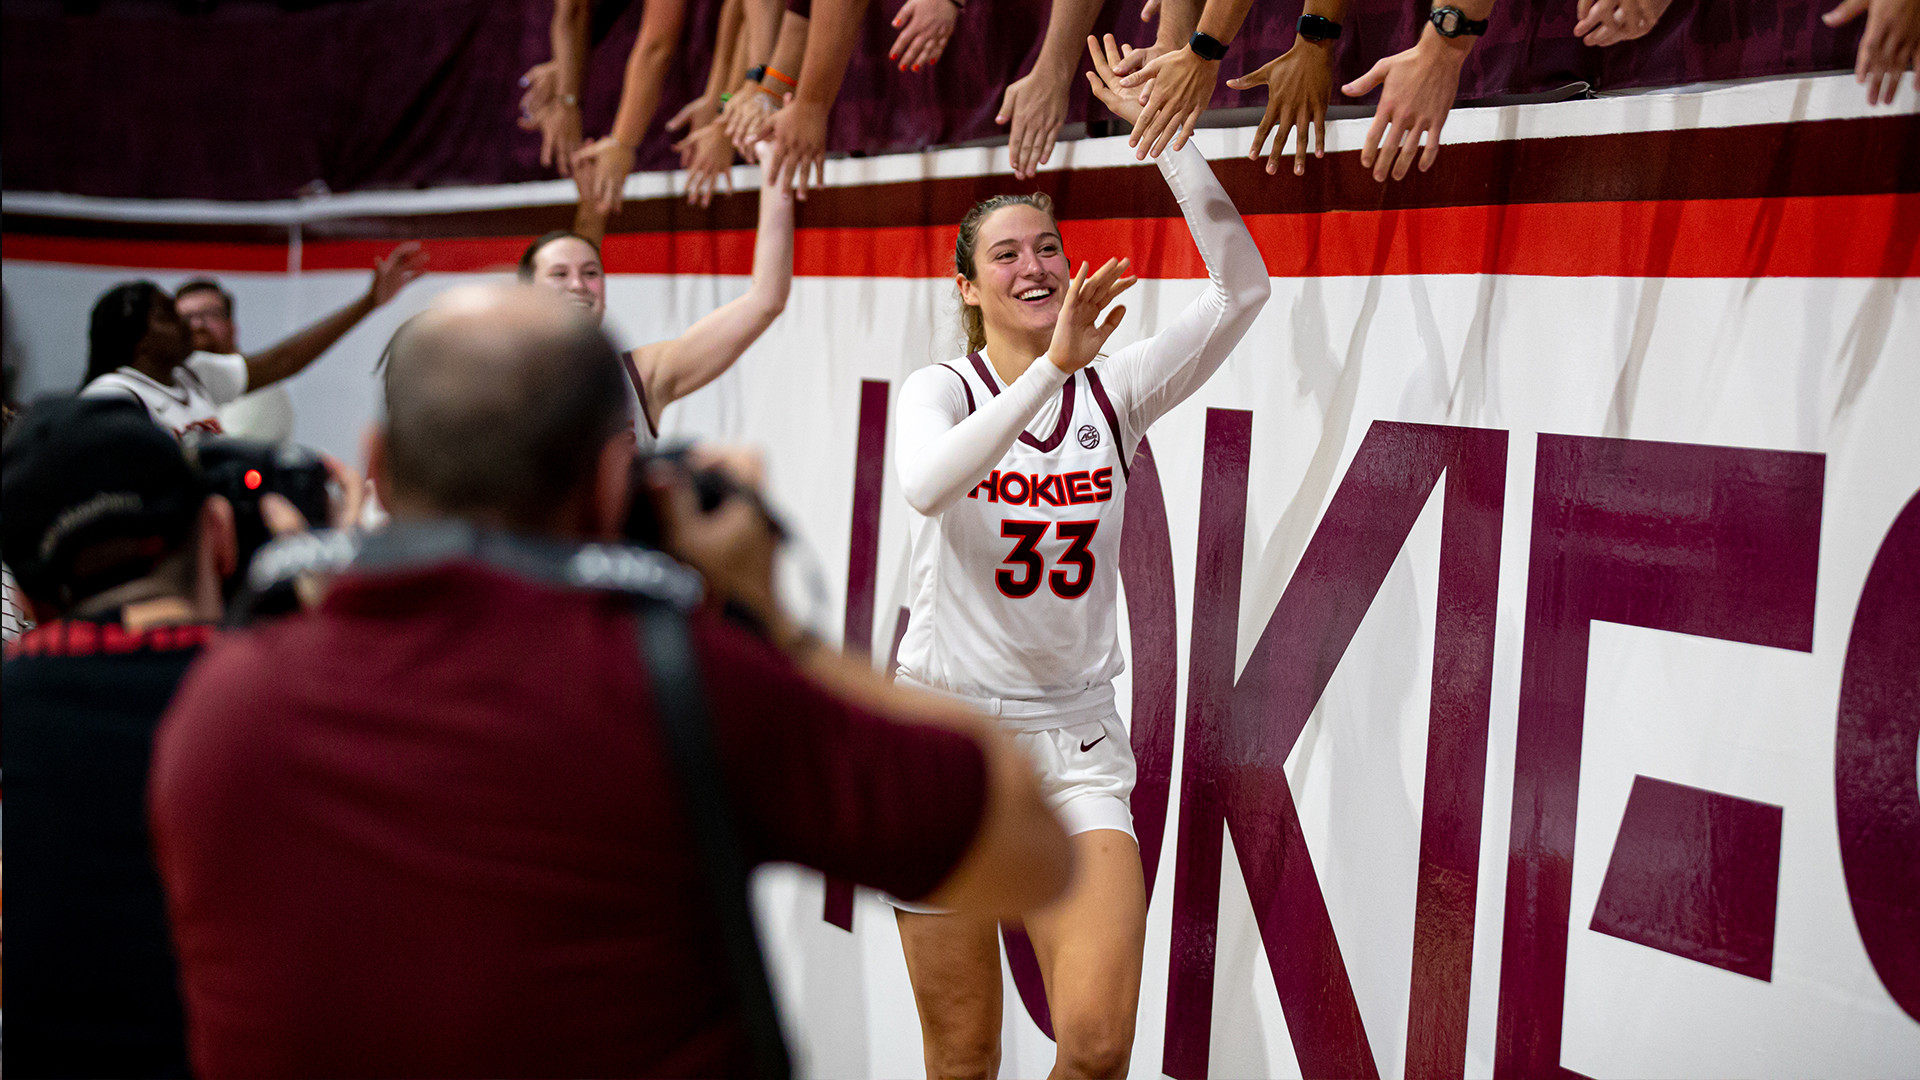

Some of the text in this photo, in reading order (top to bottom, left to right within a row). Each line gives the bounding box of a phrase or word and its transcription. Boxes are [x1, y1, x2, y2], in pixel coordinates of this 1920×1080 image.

[967, 466, 1113, 507] HOKIES
[995, 518, 1100, 600] 33
[822, 379, 1920, 1080] KIE
